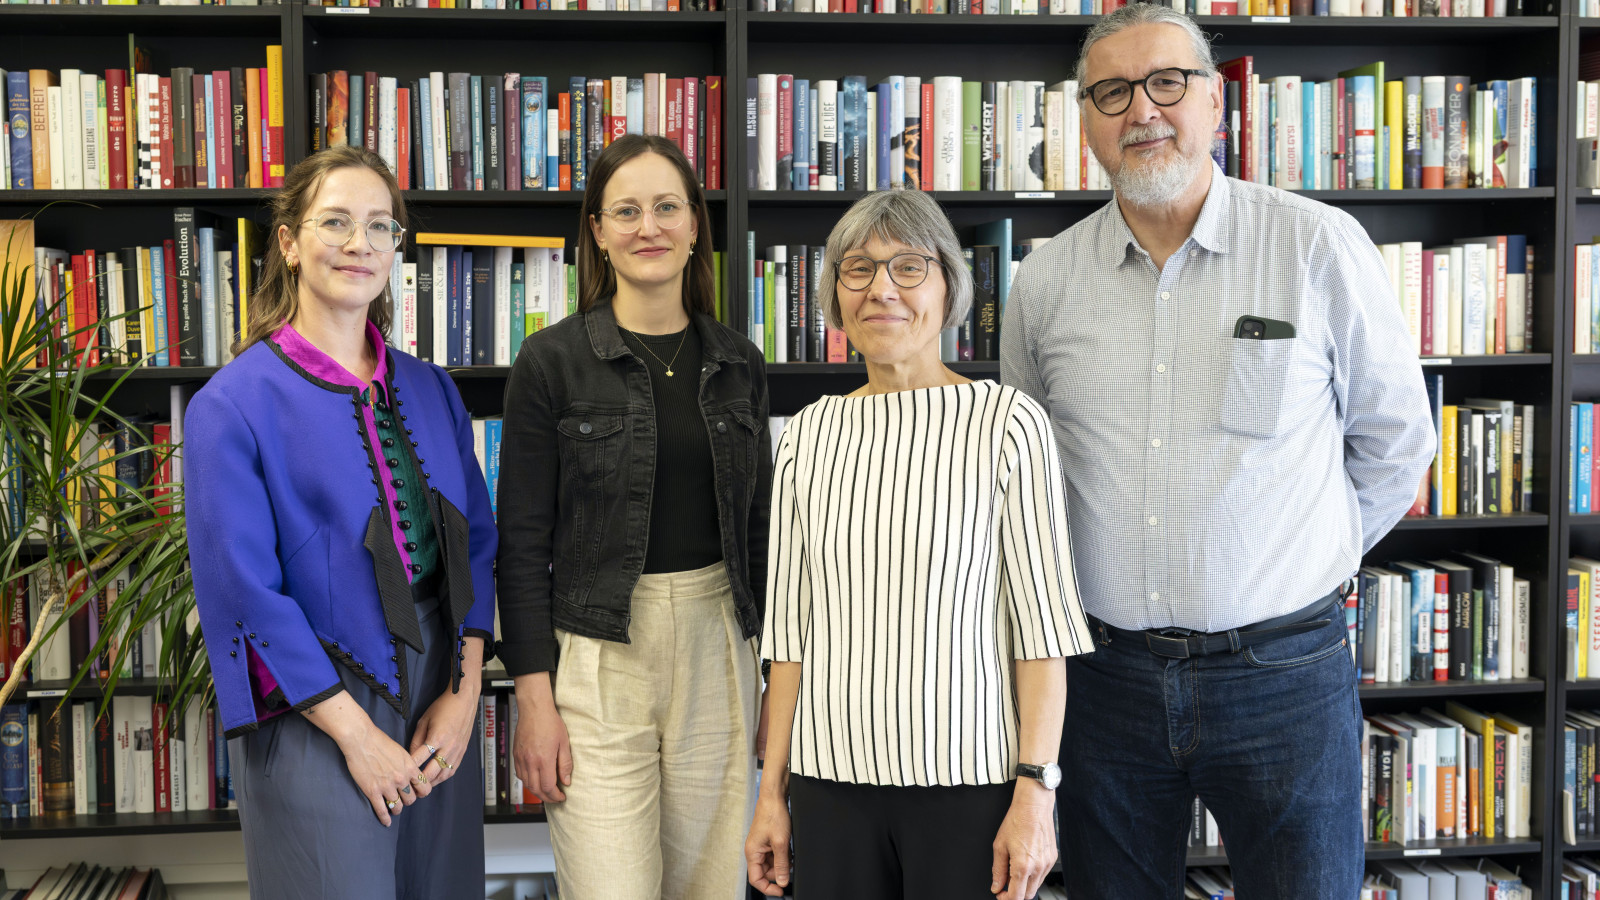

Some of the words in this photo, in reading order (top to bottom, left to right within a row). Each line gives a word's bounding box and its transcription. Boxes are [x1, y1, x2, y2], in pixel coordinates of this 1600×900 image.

[33, 87, 46, 131] BEFREIT
[746, 98, 756, 137] MASCHINE
[822, 102, 834, 121] LÜGE
[1408, 94, 1416, 135] McDERMID
[1449, 94, 1461, 135] MEYER
[86, 128, 95, 143] OSANG
[824, 126, 834, 138] DIE
[982, 101, 994, 161] WICKERT
[1408, 136, 1416, 150] VAL
[86, 144, 96, 170] ALEXANDER
[1288, 147, 1296, 182] GREGOR
[1449, 137, 1461, 177] DEON
[153, 250, 162, 288] DDR-IRRTÜMER
[179, 228, 189, 276] Evolution
[1472, 251, 1481, 286] AZUHR
[437, 266, 444, 276] ER
[204, 273, 214, 308] gefunden
[986, 300, 994, 332] KINKEL
[1470, 290, 1481, 331] HENNEN
[1462, 592, 1470, 628] MARLOW
[486, 705, 494, 737] Bluff!
[1383, 750, 1391, 778] HYDE
